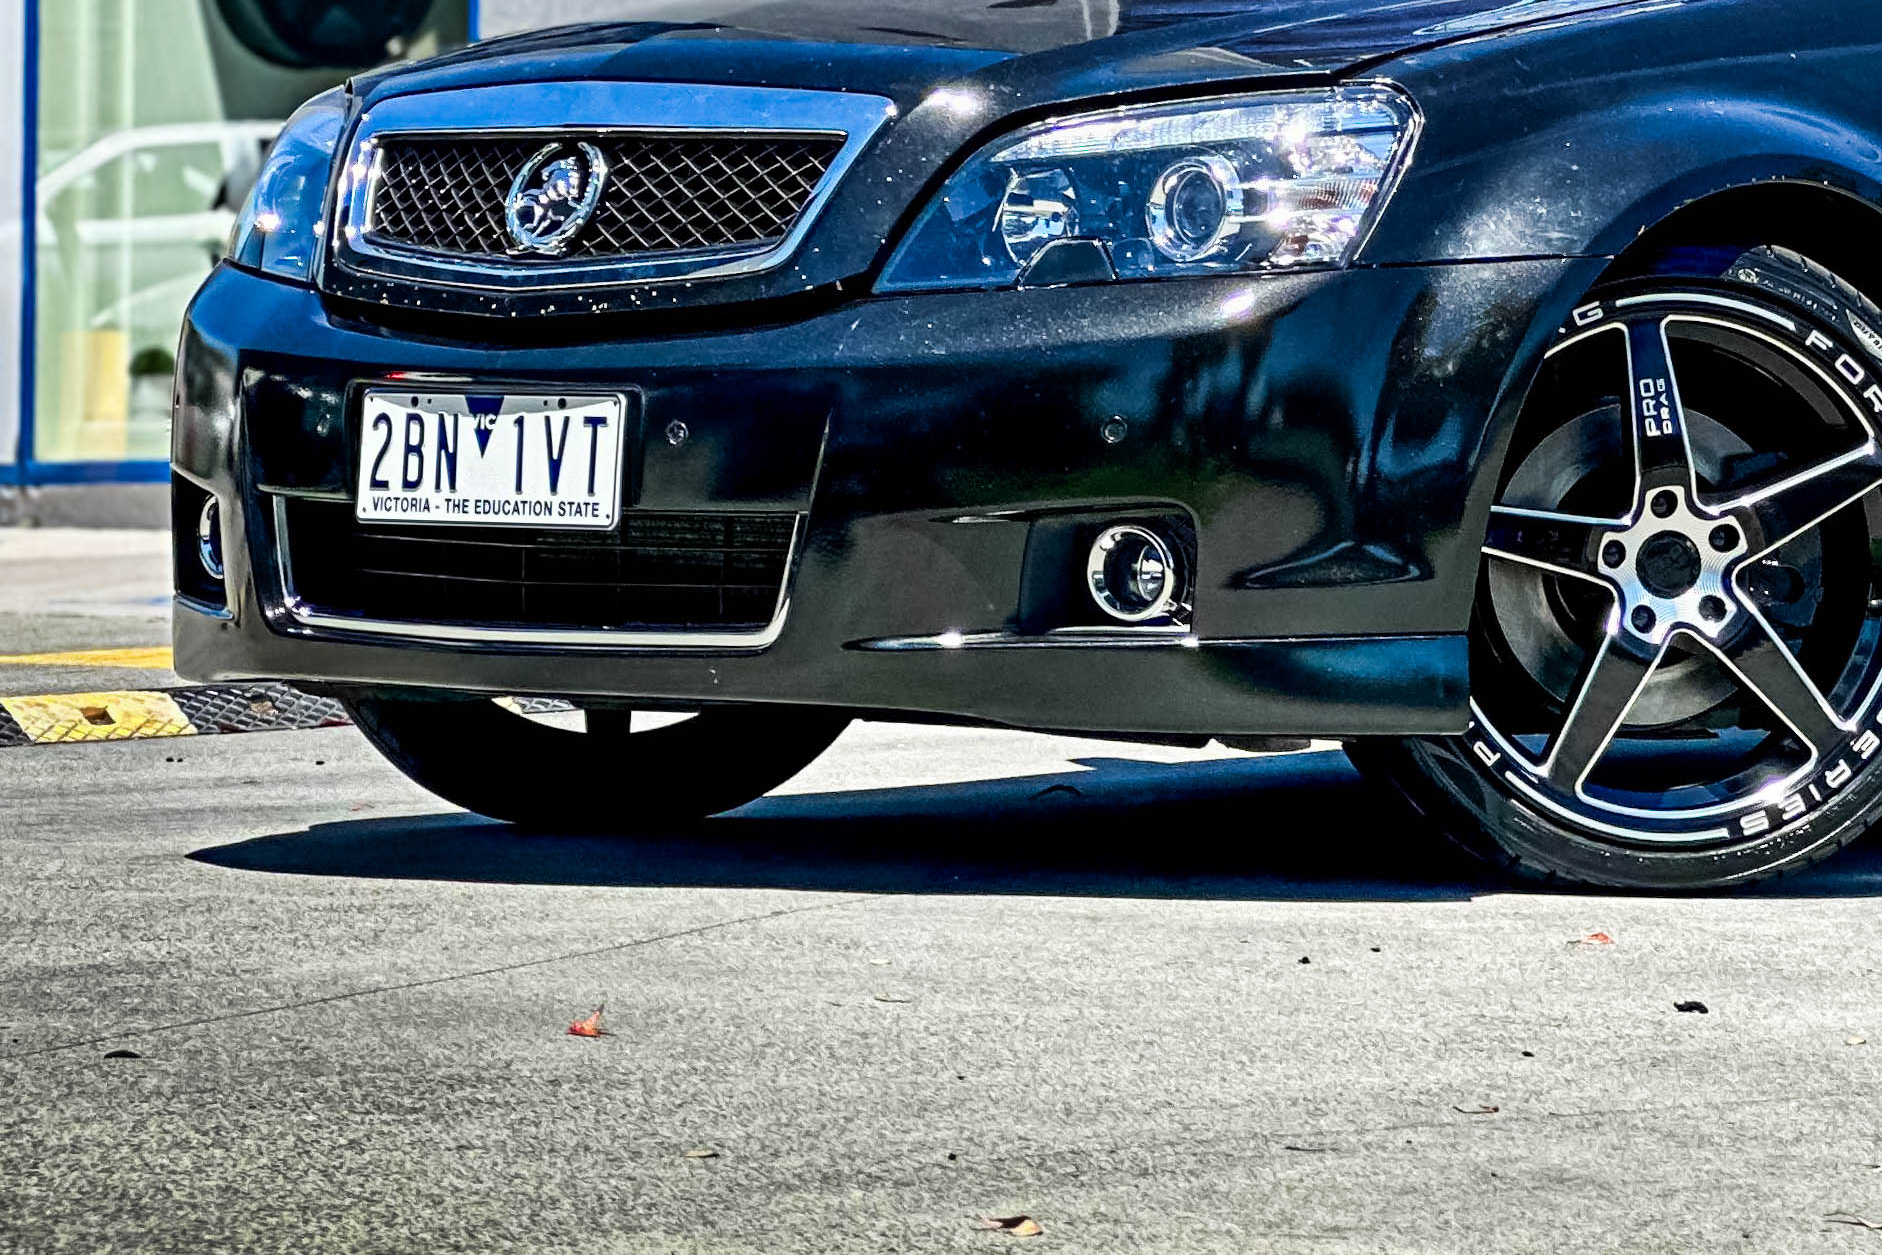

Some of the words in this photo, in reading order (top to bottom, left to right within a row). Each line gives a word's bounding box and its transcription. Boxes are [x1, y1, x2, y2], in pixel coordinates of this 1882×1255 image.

[1639, 378, 1661, 437] PRO
[1656, 378, 1673, 434] DRAG
[369, 412, 458, 491] 2BN
[513, 415, 608, 496] 1VT
[372, 497, 431, 514] VICTORIA
[445, 498, 470, 514] THE
[474, 499, 552, 516] EDUCATION
[557, 501, 600, 518] STATE
